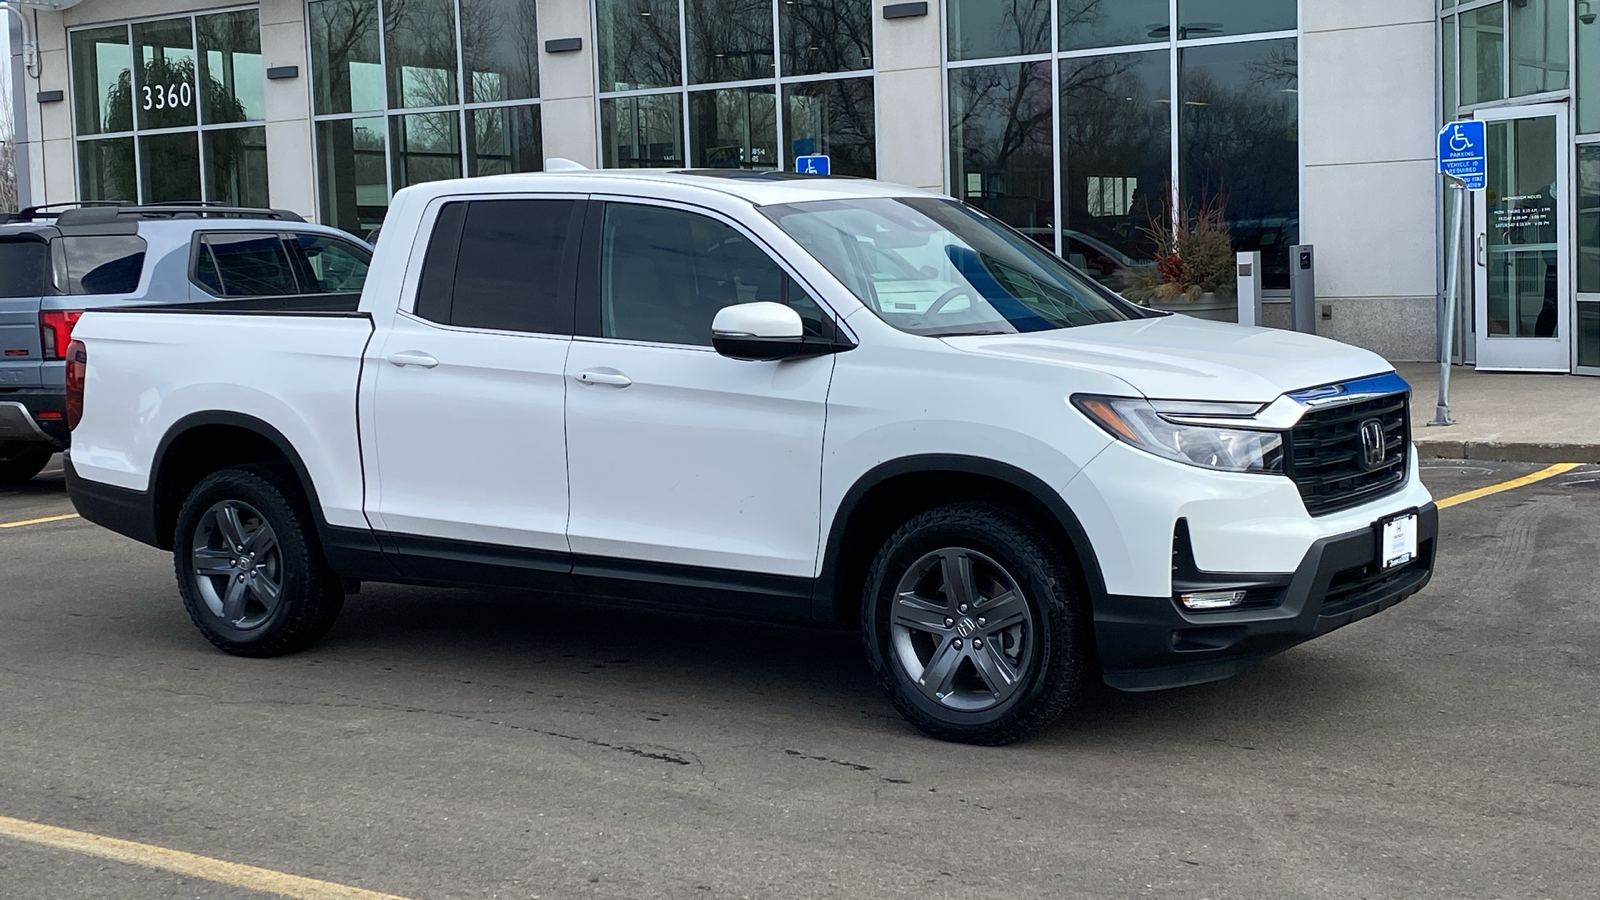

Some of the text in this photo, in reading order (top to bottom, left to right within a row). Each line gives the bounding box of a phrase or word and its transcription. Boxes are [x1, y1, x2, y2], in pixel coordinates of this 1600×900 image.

[142, 82, 191, 110] 3360
[1446, 161, 1470, 169] VEHICLE
[1448, 166, 1477, 174] REQUIRED
